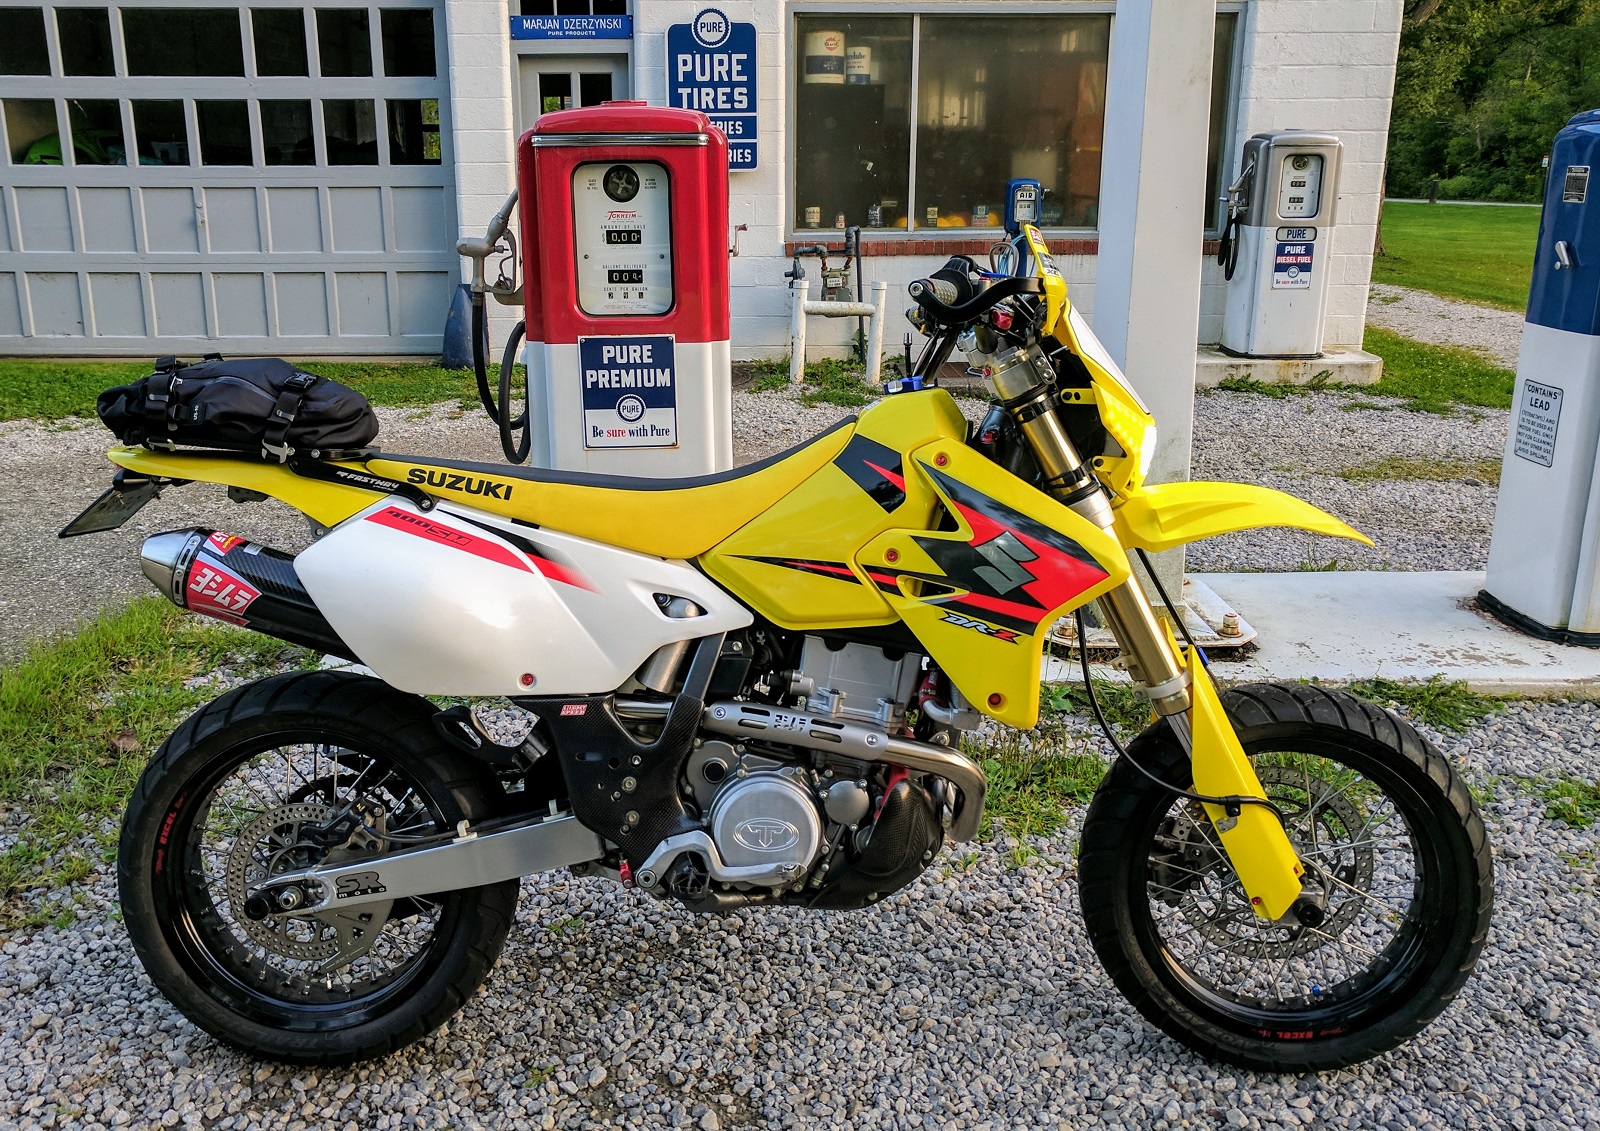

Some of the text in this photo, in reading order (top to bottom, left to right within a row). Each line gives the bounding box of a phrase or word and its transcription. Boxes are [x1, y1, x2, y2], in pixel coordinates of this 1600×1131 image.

[523, 18, 622, 30] MARJAN DZERZYNSKI
[700, 22, 723, 33] PURE
[677, 53, 748, 82] PURE
[677, 87, 748, 110] TIRES
[711, 121, 743, 135] RIES
[1286, 229, 1307, 239] PURE
[1284, 245, 1306, 255] PURE
[602, 345, 653, 364] PURE
[586, 368, 671, 389] PREMIUM
[1527, 384, 1558, 400] CONTAINS
[621, 404, 640, 413] PURE
[1529, 396, 1550, 411] LEAD
[592, 424, 670, 438] Be sure with Pure
[1532, 429, 1541, 437] FUEL
[1536, 422, 1547, 430] USED
[347, 473, 400, 489] FASTWAY
[406, 468, 513, 501] SUZUKI
[940, 611, 1021, 644] DR-Z
[160, 811, 177, 845] EXCEL
[335, 870, 382, 893] SR
[338, 886, 386, 899] moto
[1276, 1030, 1314, 1040] EXCEL
